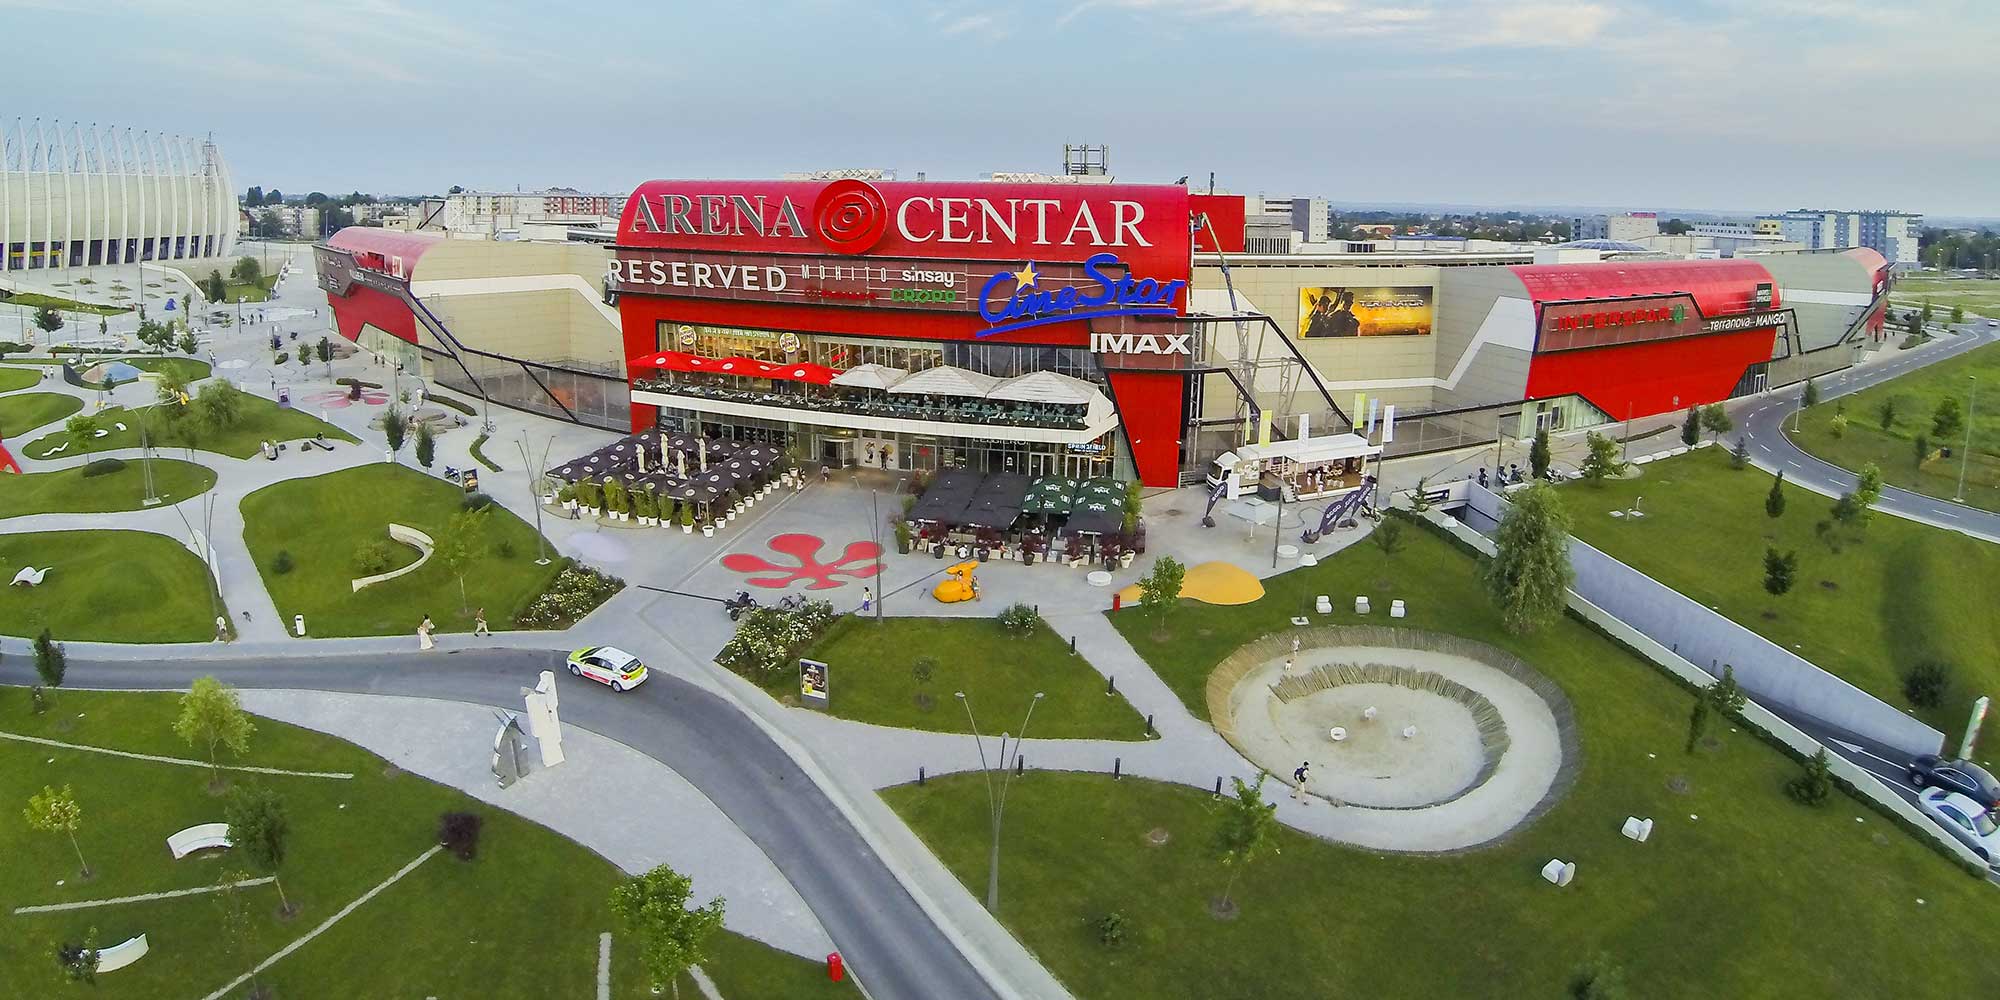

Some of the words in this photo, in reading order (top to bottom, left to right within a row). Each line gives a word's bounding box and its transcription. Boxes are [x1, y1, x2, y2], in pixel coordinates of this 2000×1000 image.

[627, 193, 809, 238] ARENA
[896, 196, 1153, 247] CENTAR
[607, 258, 788, 293] RESERVED
[801, 264, 888, 283] MOHITO
[902, 266, 955, 288] sinsay
[977, 252, 1186, 325] CineStar
[1558, 306, 1670, 332] INTERSPAR
[1755, 312, 1785, 327] MANGO
[1090, 333, 1192, 355] IMAX
